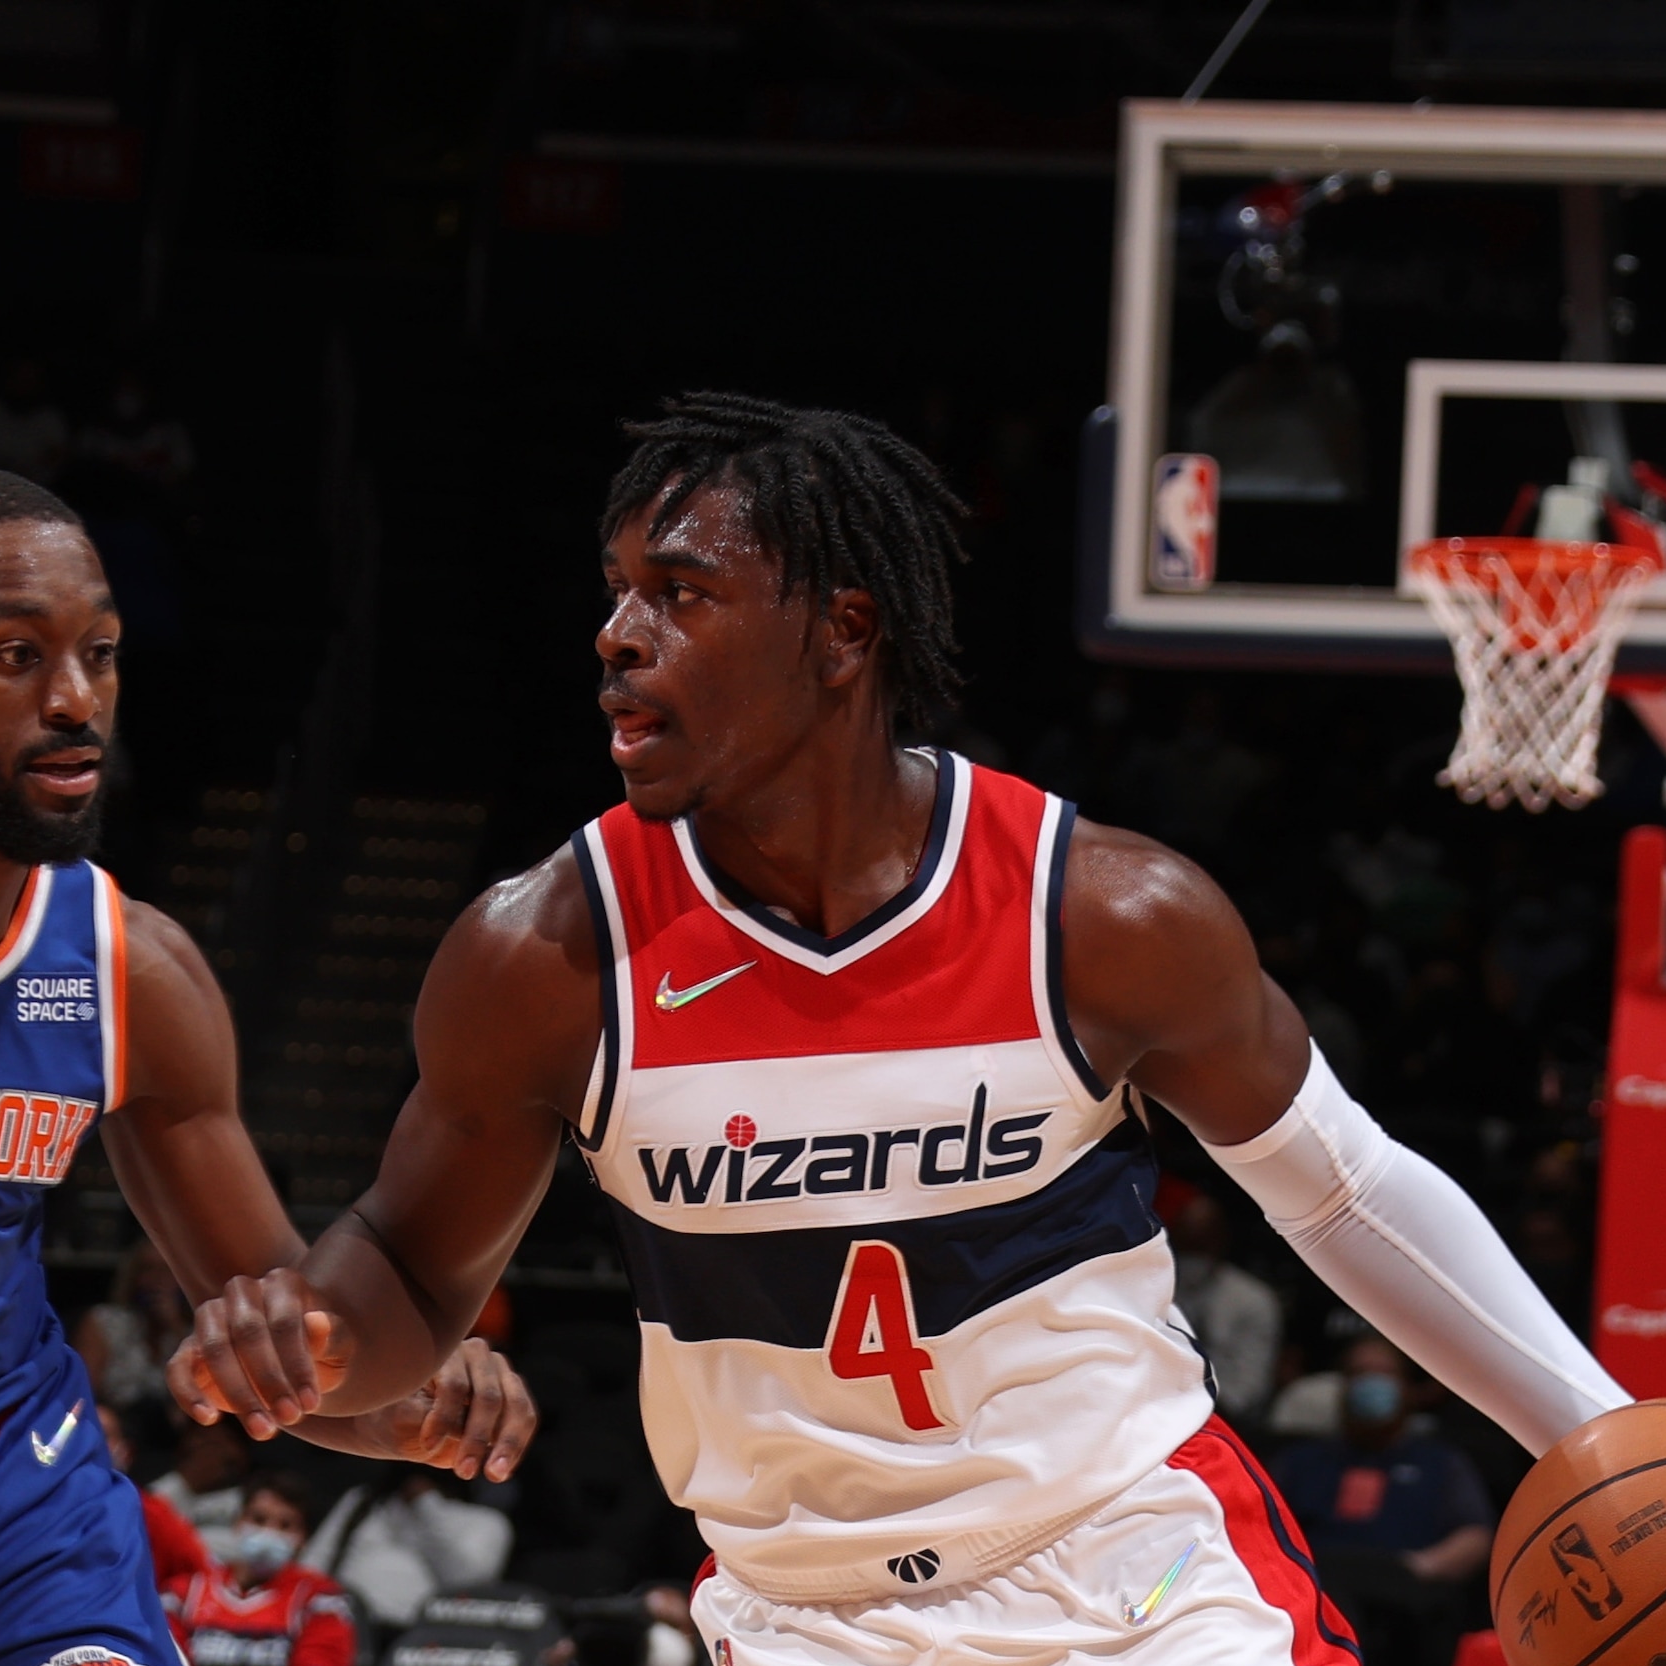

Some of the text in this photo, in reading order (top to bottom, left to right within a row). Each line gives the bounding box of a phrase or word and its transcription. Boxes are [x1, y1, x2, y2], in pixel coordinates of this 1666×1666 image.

[17, 978, 94, 999] SQUARE
[17, 1002, 78, 1021] SPACE
[639, 1082, 1053, 1203] wizards
[827, 1241, 951, 1434] 4
